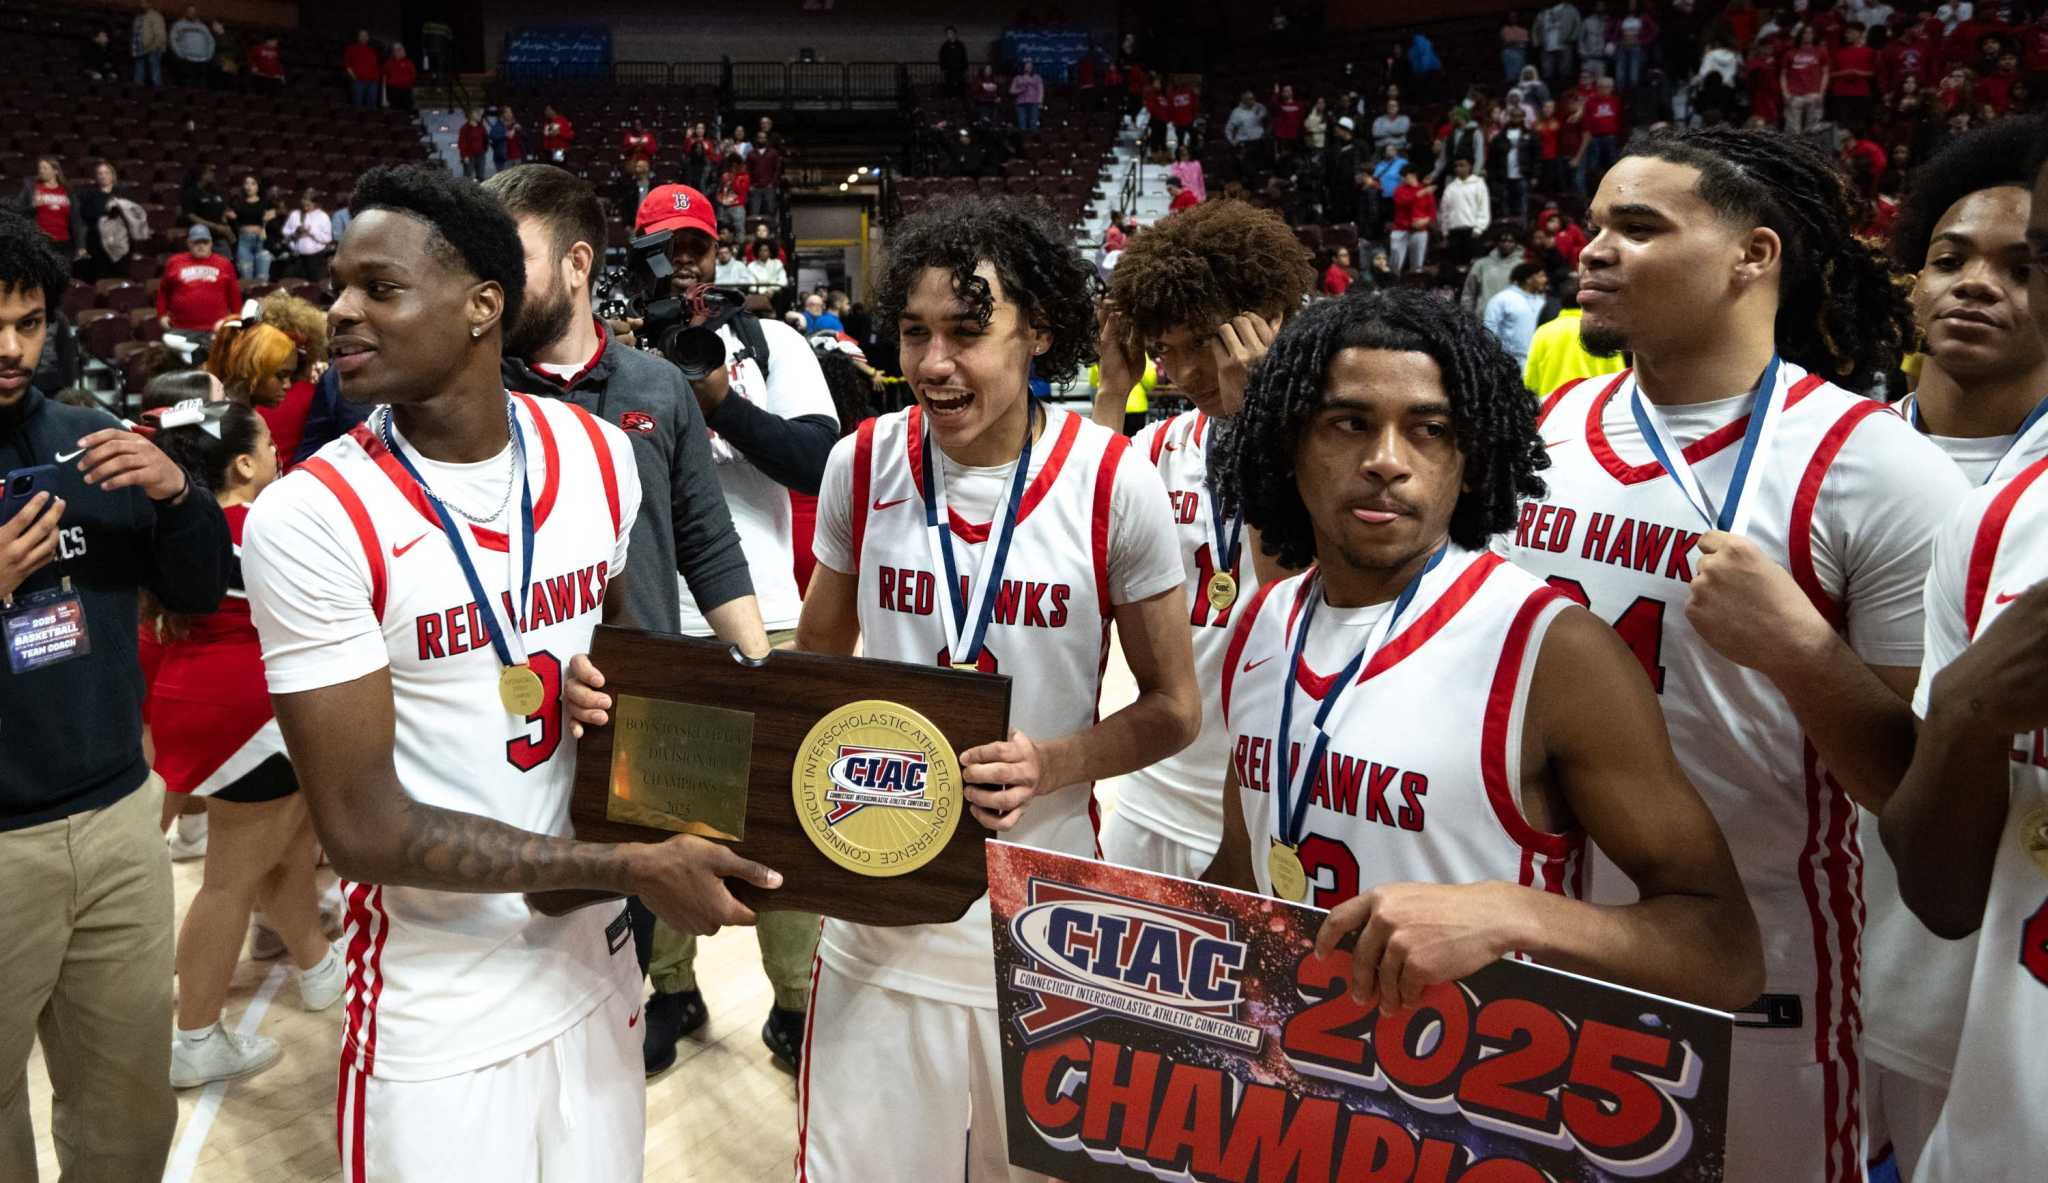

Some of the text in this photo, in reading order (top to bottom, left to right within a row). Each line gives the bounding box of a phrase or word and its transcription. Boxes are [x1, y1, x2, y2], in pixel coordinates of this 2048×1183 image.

[672, 191, 690, 210] B
[1515, 502, 1707, 583] RED HAWK
[879, 565, 935, 616] RED
[15, 624, 79, 646] BASKETBALL
[21, 645, 47, 659] TEAM
[47, 638, 77, 653] COACH
[32, 616, 57, 628] 2025
[416, 602, 492, 661] RED
[506, 649, 562, 773] 3
[641, 771, 718, 793] CHAMPIONS
[803, 713, 951, 865] CONNECTICUT INTERSCHOLASTIC ATHLETIC CONFERENCE
[844, 757, 928, 792] CIAC
[1047, 906, 1247, 1001] CIAC
[1019, 974, 1255, 1044] CONNECTICUT INTERSCHOLASTIC ATHLETIC CONFERENCE
[1282, 947, 1673, 1149] 2025
